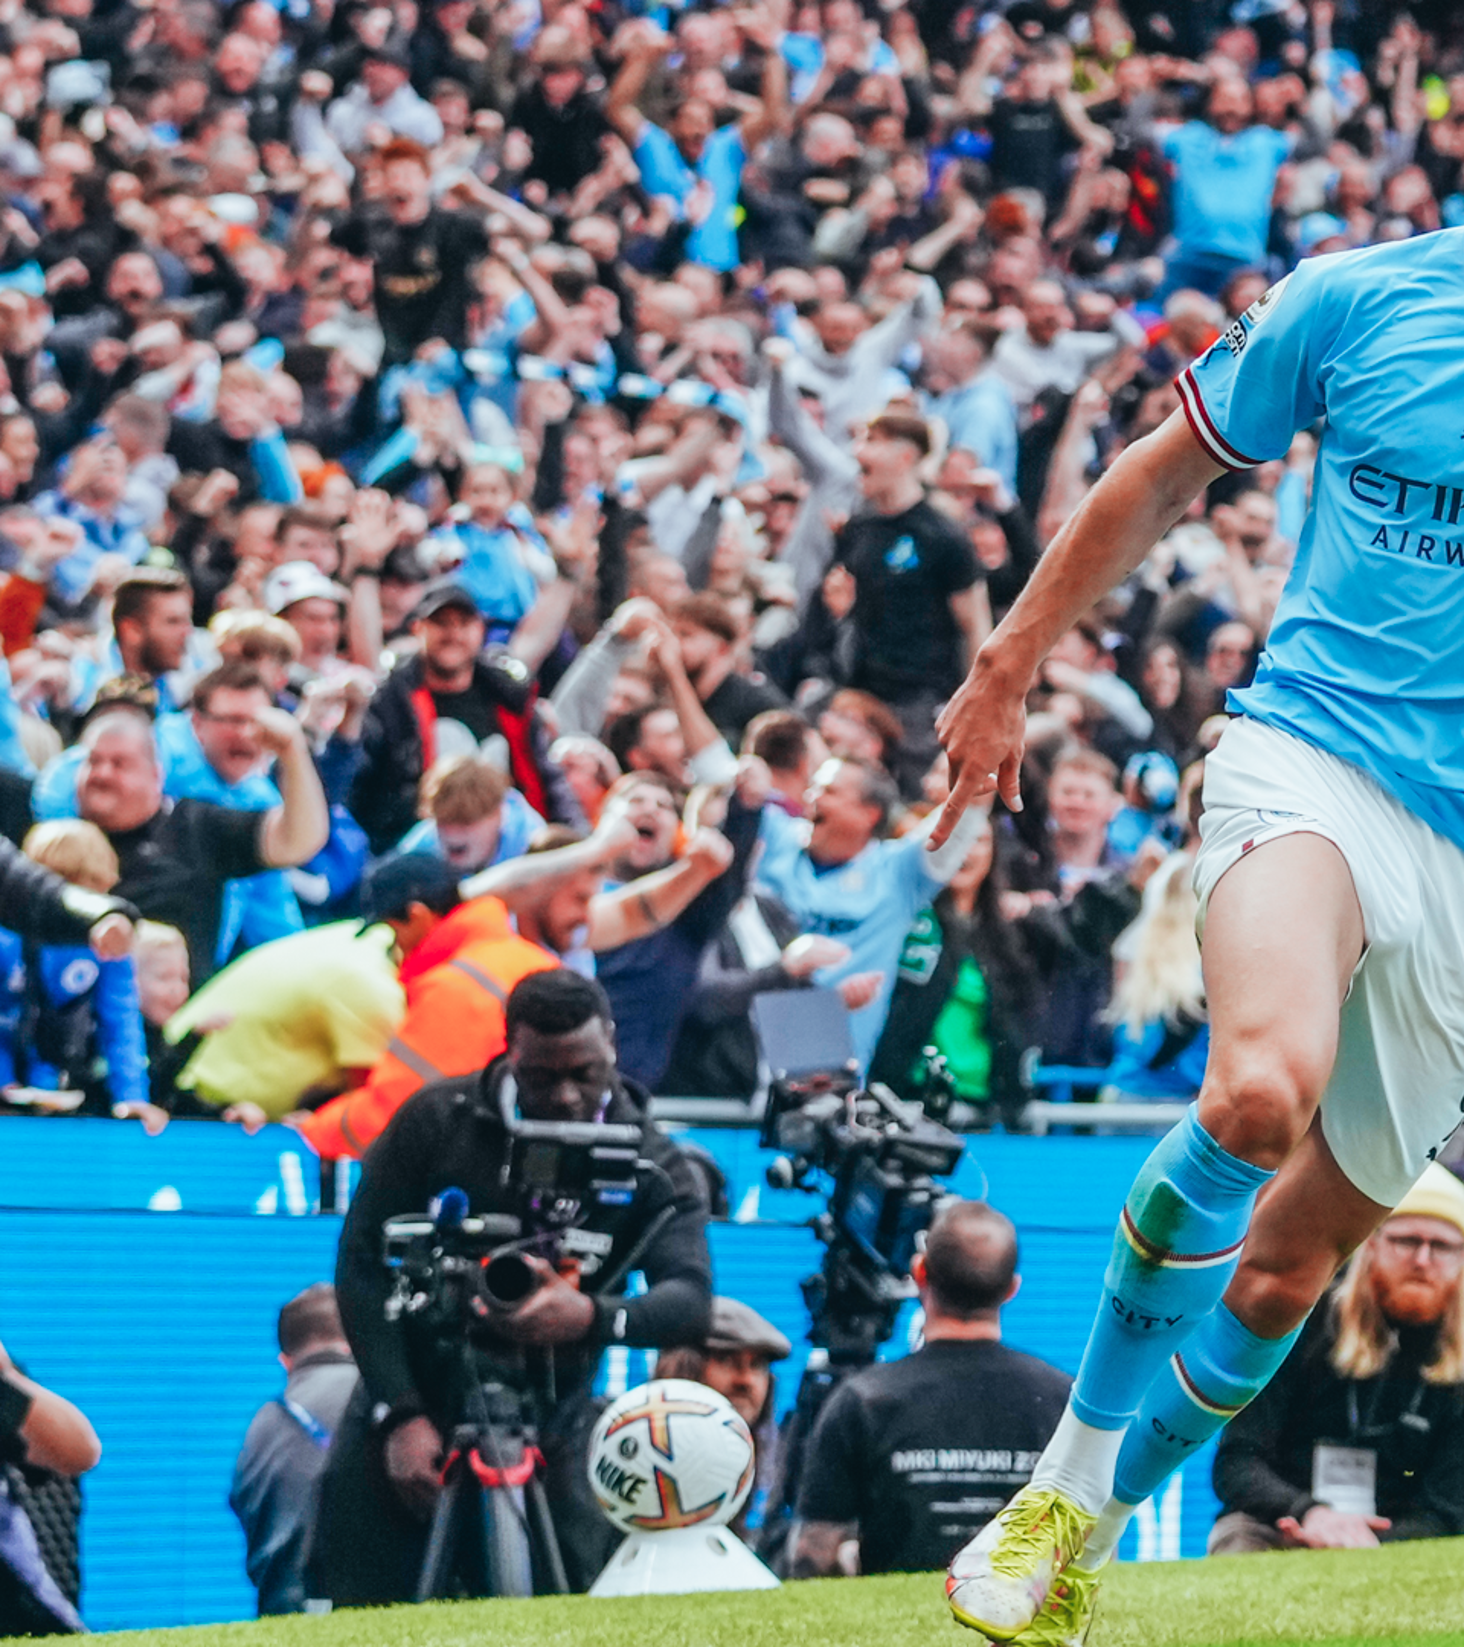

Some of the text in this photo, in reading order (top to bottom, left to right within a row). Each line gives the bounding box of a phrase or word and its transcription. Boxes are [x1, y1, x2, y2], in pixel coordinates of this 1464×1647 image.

[1112, 1296, 1184, 1329] CITY
[1152, 1417, 1208, 1447] CIT
[595, 1455, 648, 1507] NIKE
